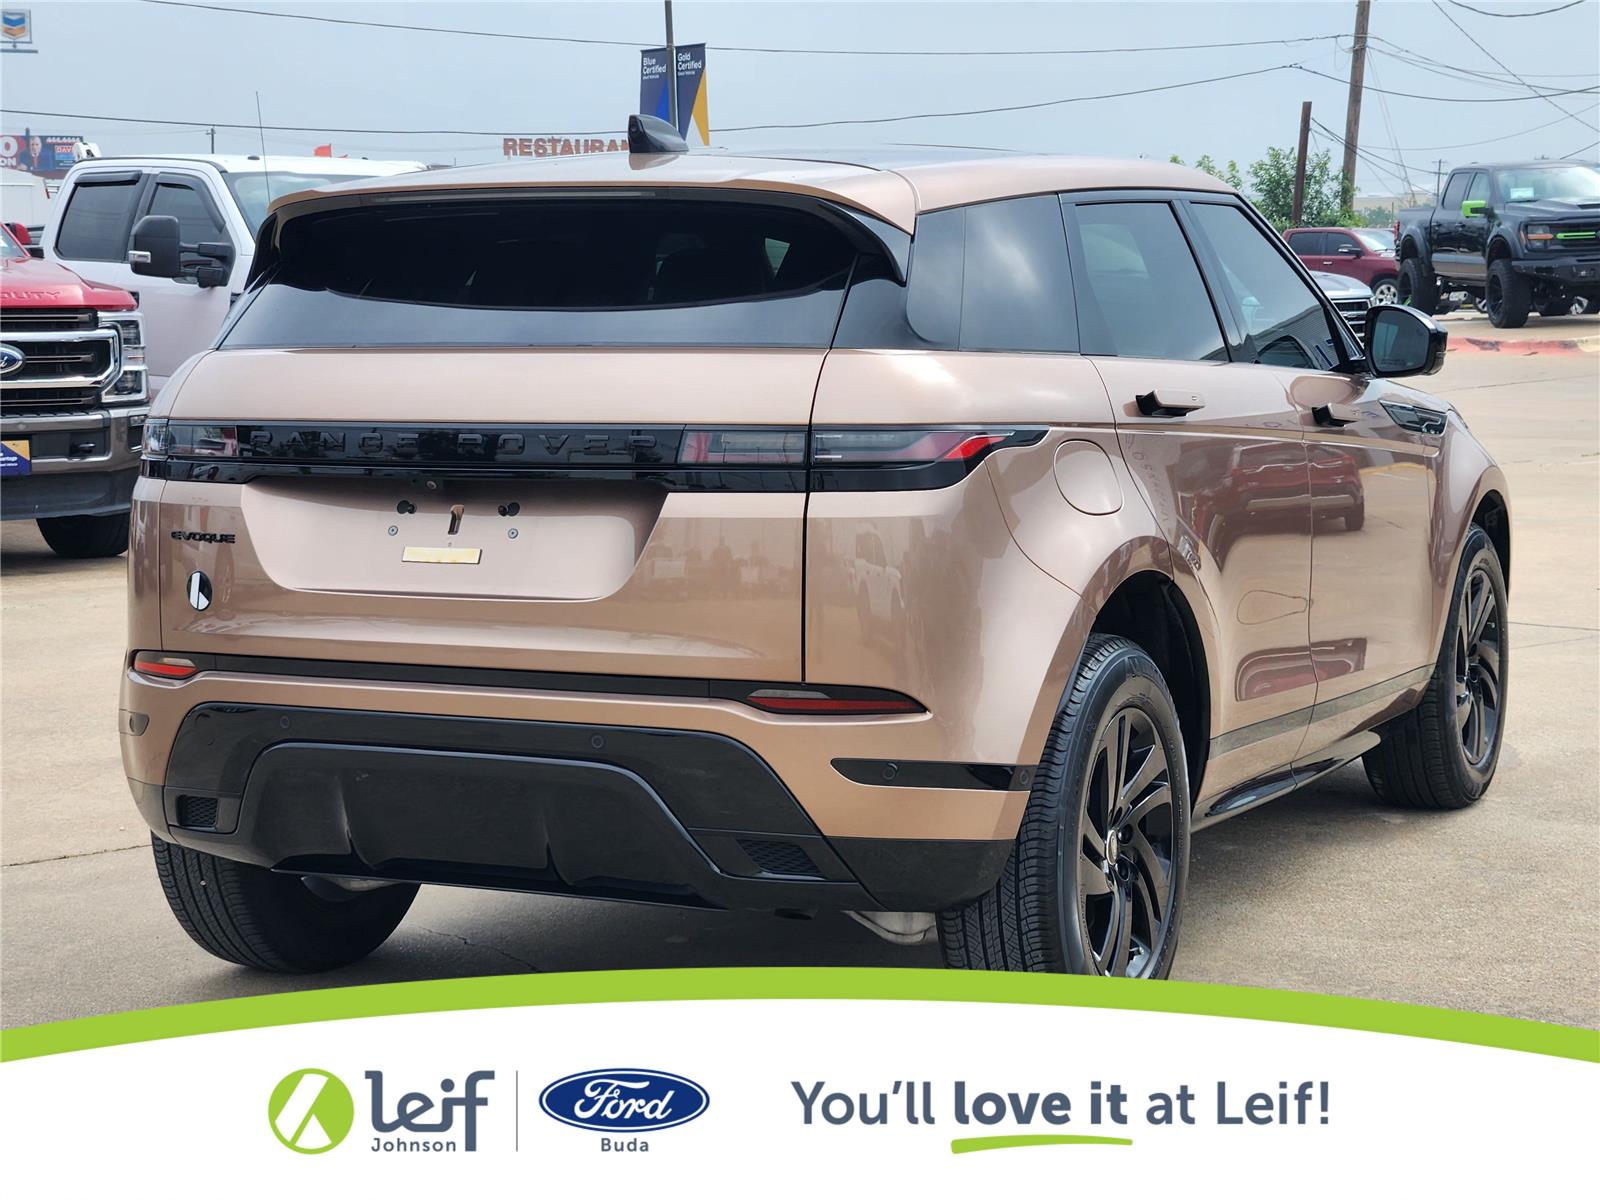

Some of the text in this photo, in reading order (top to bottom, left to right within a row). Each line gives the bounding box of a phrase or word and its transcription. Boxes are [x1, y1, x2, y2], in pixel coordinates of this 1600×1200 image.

[643, 57, 656, 66] Blue
[678, 53, 690, 61] Gold
[643, 64, 667, 75] Certified
[678, 60, 702, 71] Certified
[503, 137, 629, 157] RESTAURAN
[249, 429, 659, 458] RANGE ROVER
[171, 531, 236, 544] EVOQUE
